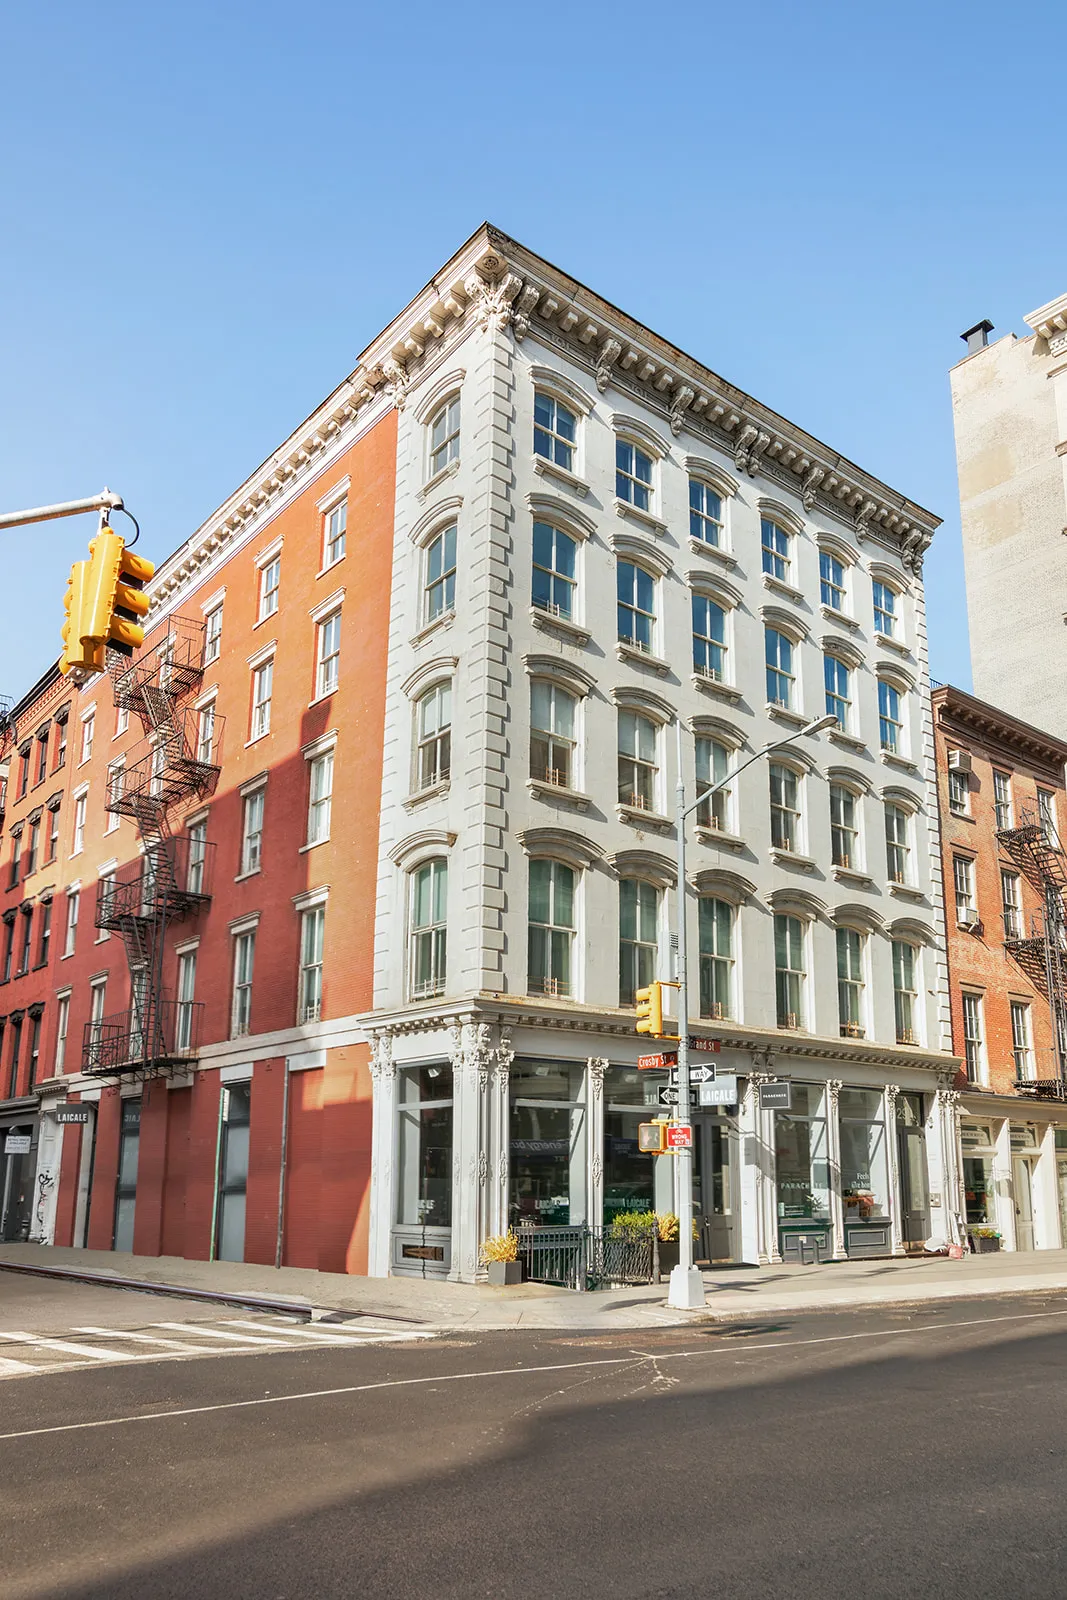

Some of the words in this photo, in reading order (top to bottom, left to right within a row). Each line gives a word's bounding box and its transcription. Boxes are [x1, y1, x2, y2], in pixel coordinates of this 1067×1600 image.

[708, 1041, 715, 1051] St
[639, 1056, 659, 1068] Crosby
[661, 1055, 667, 1065] St
[695, 1070, 709, 1079] WAY
[664, 1091, 676, 1101] ONE
[701, 1089, 735, 1103] LAICALE
[58, 1113, 88, 1122] LAICALE
